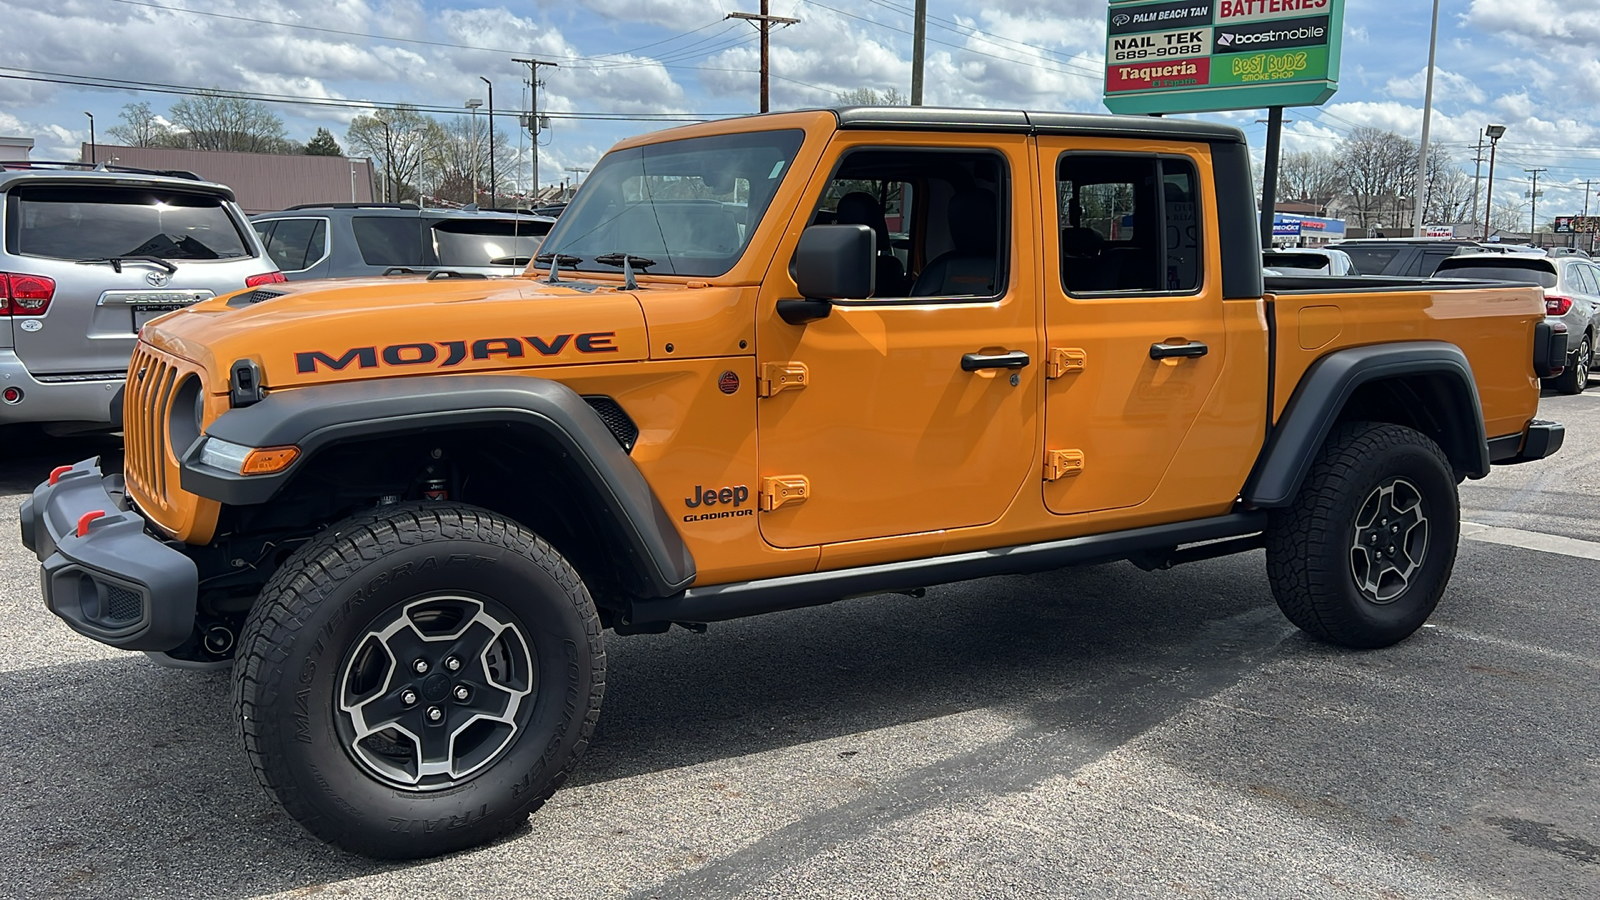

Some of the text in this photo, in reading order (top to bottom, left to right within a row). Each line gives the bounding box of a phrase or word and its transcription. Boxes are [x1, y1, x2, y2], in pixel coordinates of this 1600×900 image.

[1132, 6, 1209, 23] PALM BEACH TAN
[1114, 31, 1203, 50] NAIL TEK
[1115, 44, 1201, 60] 689-9088
[1267, 51, 1307, 72] BUDZ
[1242, 71, 1295, 81] SMOKE SHOP
[294, 332, 619, 374] MOJAVE
[684, 484, 749, 508] Jeep
[683, 509, 753, 523] GLADIATOR
